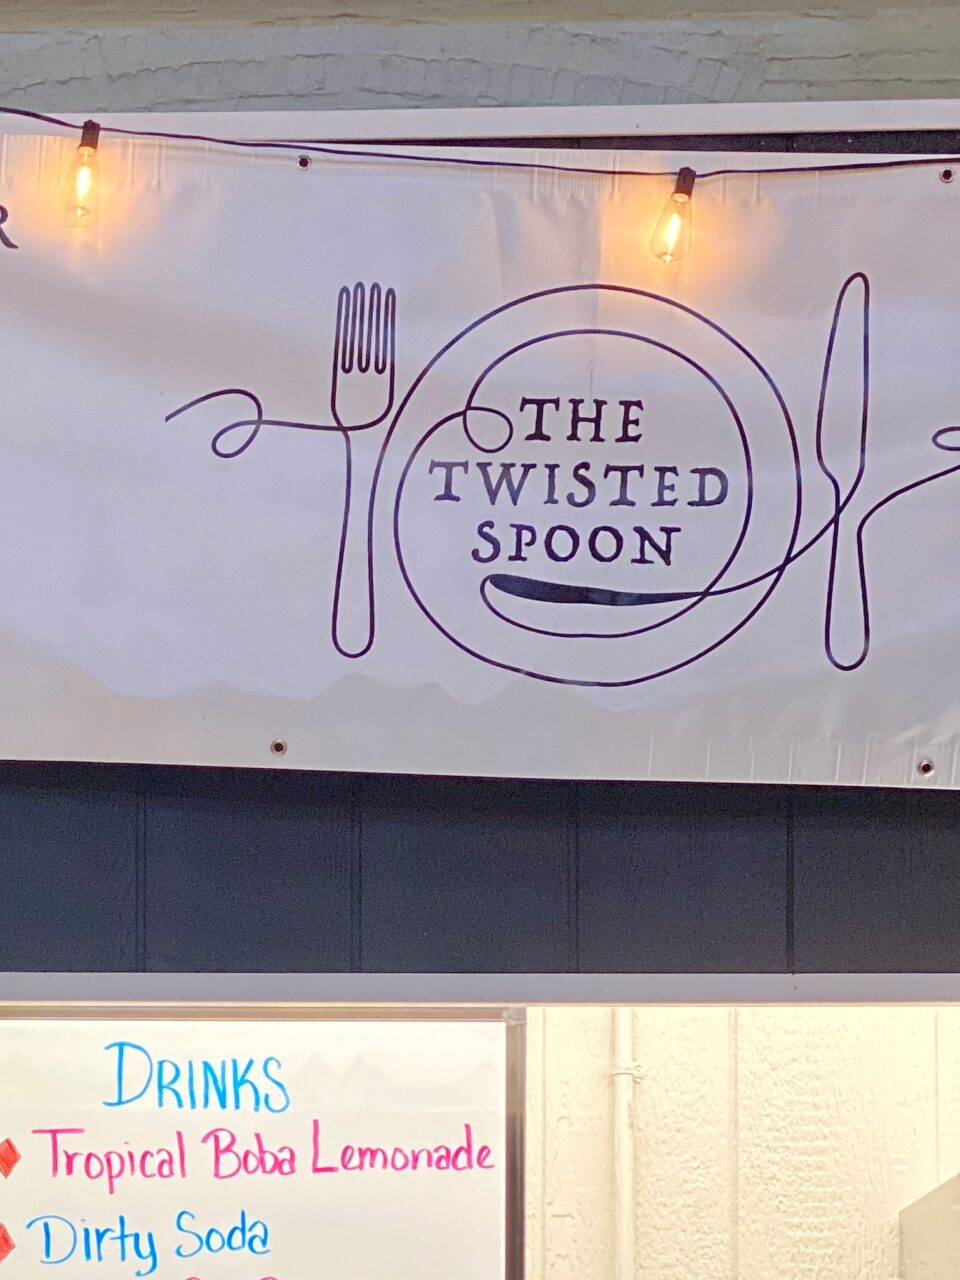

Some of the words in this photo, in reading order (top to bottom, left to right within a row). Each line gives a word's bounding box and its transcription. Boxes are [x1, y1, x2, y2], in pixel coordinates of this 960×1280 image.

[519, 397, 645, 443] THE
[428, 459, 729, 508] TWISTED
[471, 521, 681, 566] SPOON
[102, 1040, 291, 1114] DRINKS
[31, 1128, 187, 1195] Tropical
[201, 1127, 297, 1179] Boba
[311, 1119, 496, 1174] Lemonade
[26, 1215, 158, 1276] Dirty
[175, 1210, 271, 1258] Soda
